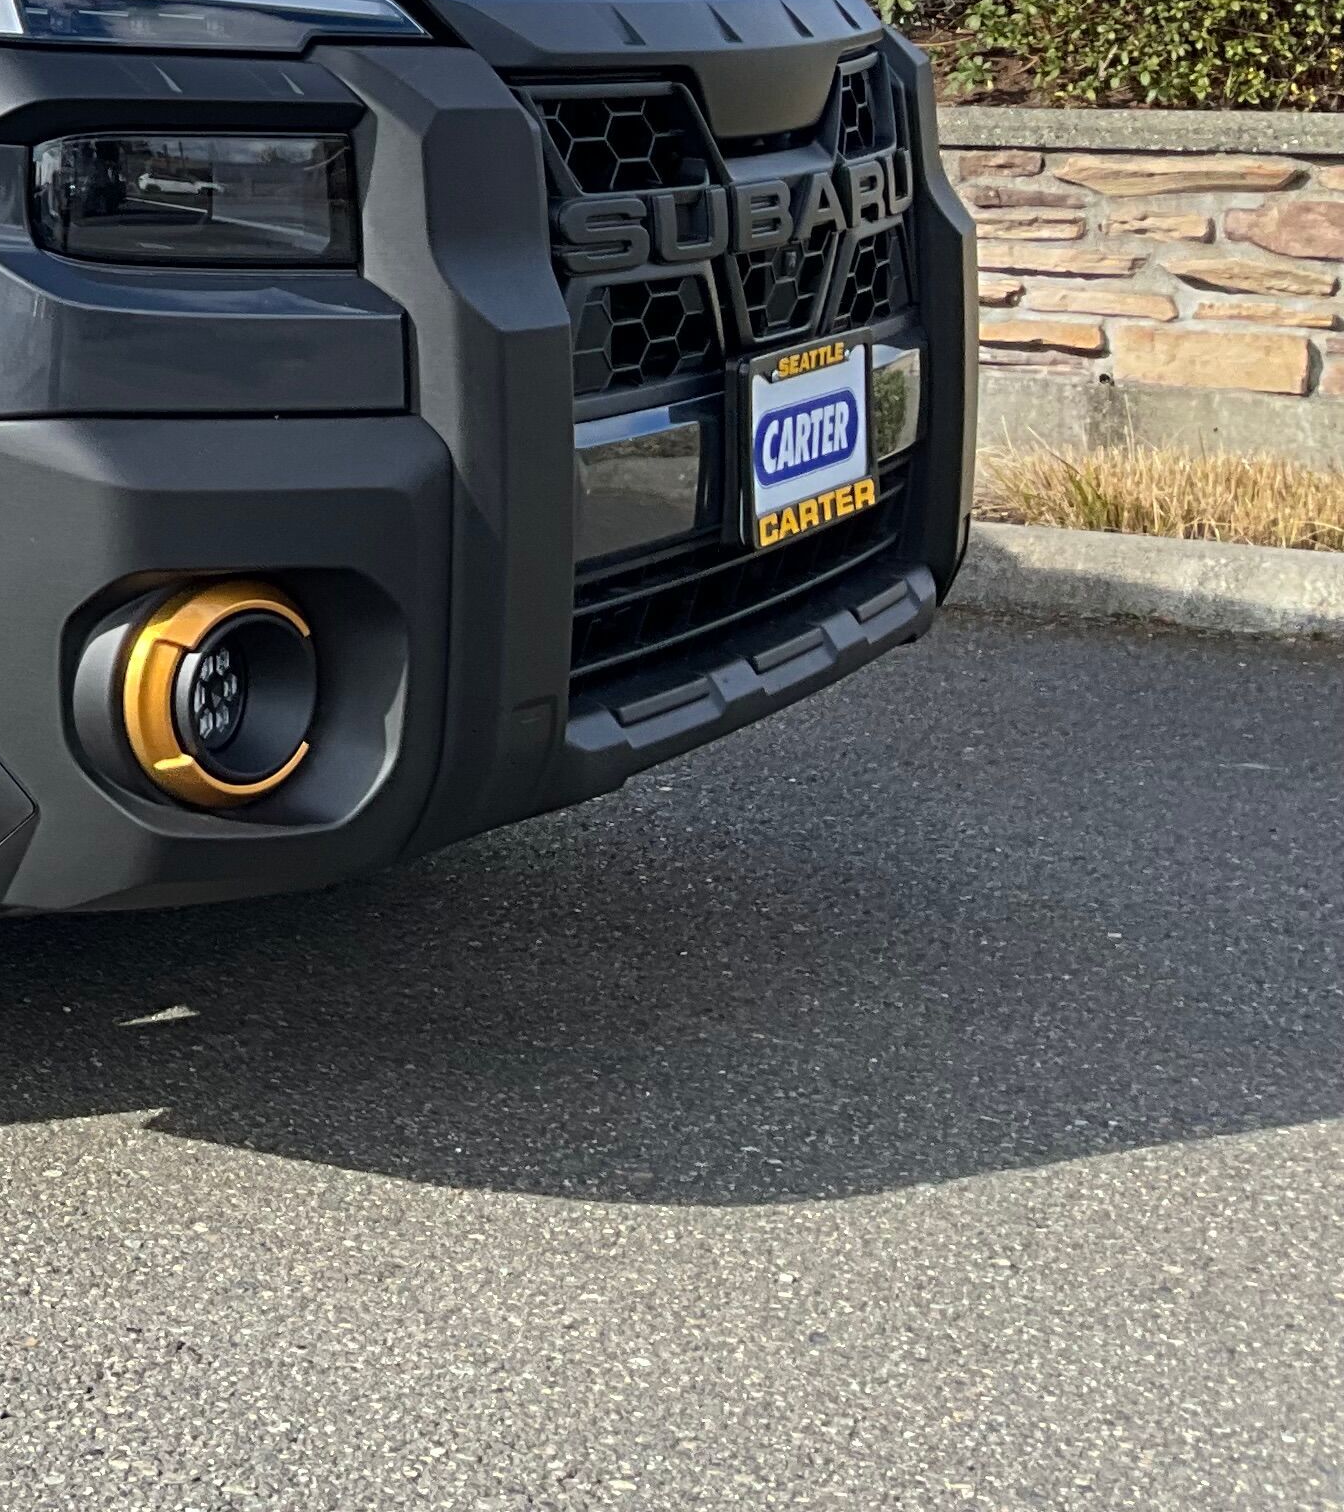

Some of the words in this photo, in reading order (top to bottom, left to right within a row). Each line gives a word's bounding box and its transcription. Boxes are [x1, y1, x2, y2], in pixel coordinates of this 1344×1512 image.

[556, 148, 913, 274] SUBARU
[777, 341, 845, 379] SEATTLE
[762, 400, 851, 475] CARTER
[758, 478, 877, 548] CARTER
